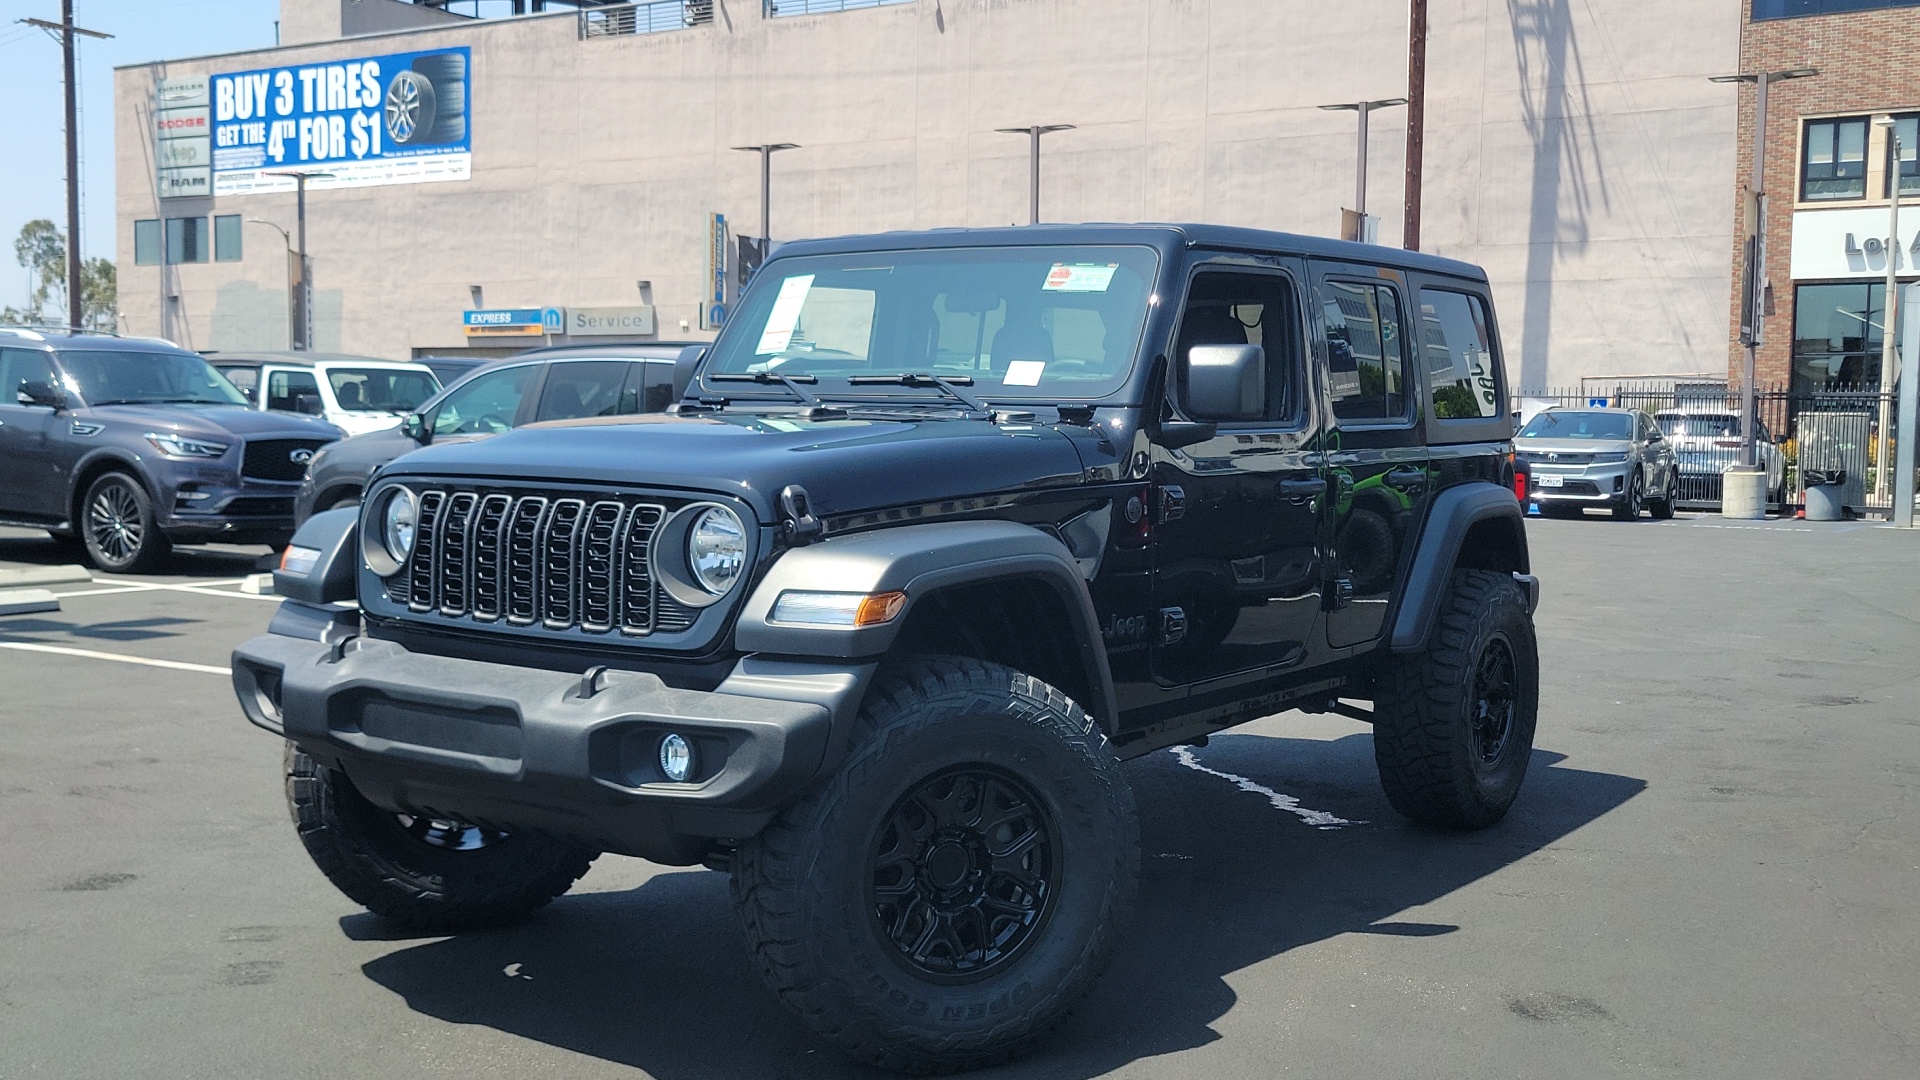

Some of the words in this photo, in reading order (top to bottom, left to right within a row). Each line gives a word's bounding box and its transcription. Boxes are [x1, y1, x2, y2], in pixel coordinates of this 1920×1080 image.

[216, 73, 270, 121] BUY
[274, 70, 294, 116] 3
[299, 61, 381, 113] TIRES
[158, 117, 205, 129] DODGE
[216, 124, 240, 147] GET
[241, 122, 266, 145] THE
[267, 119, 296, 162] 4TH
[299, 114, 347, 160] FOR
[350, 109, 381, 160] $1
[171, 177, 206, 188] RAM
[470, 312, 512, 324] EXPRESS
[577, 314, 642, 328] Service
[1104, 613, 1146, 639] Jeep
